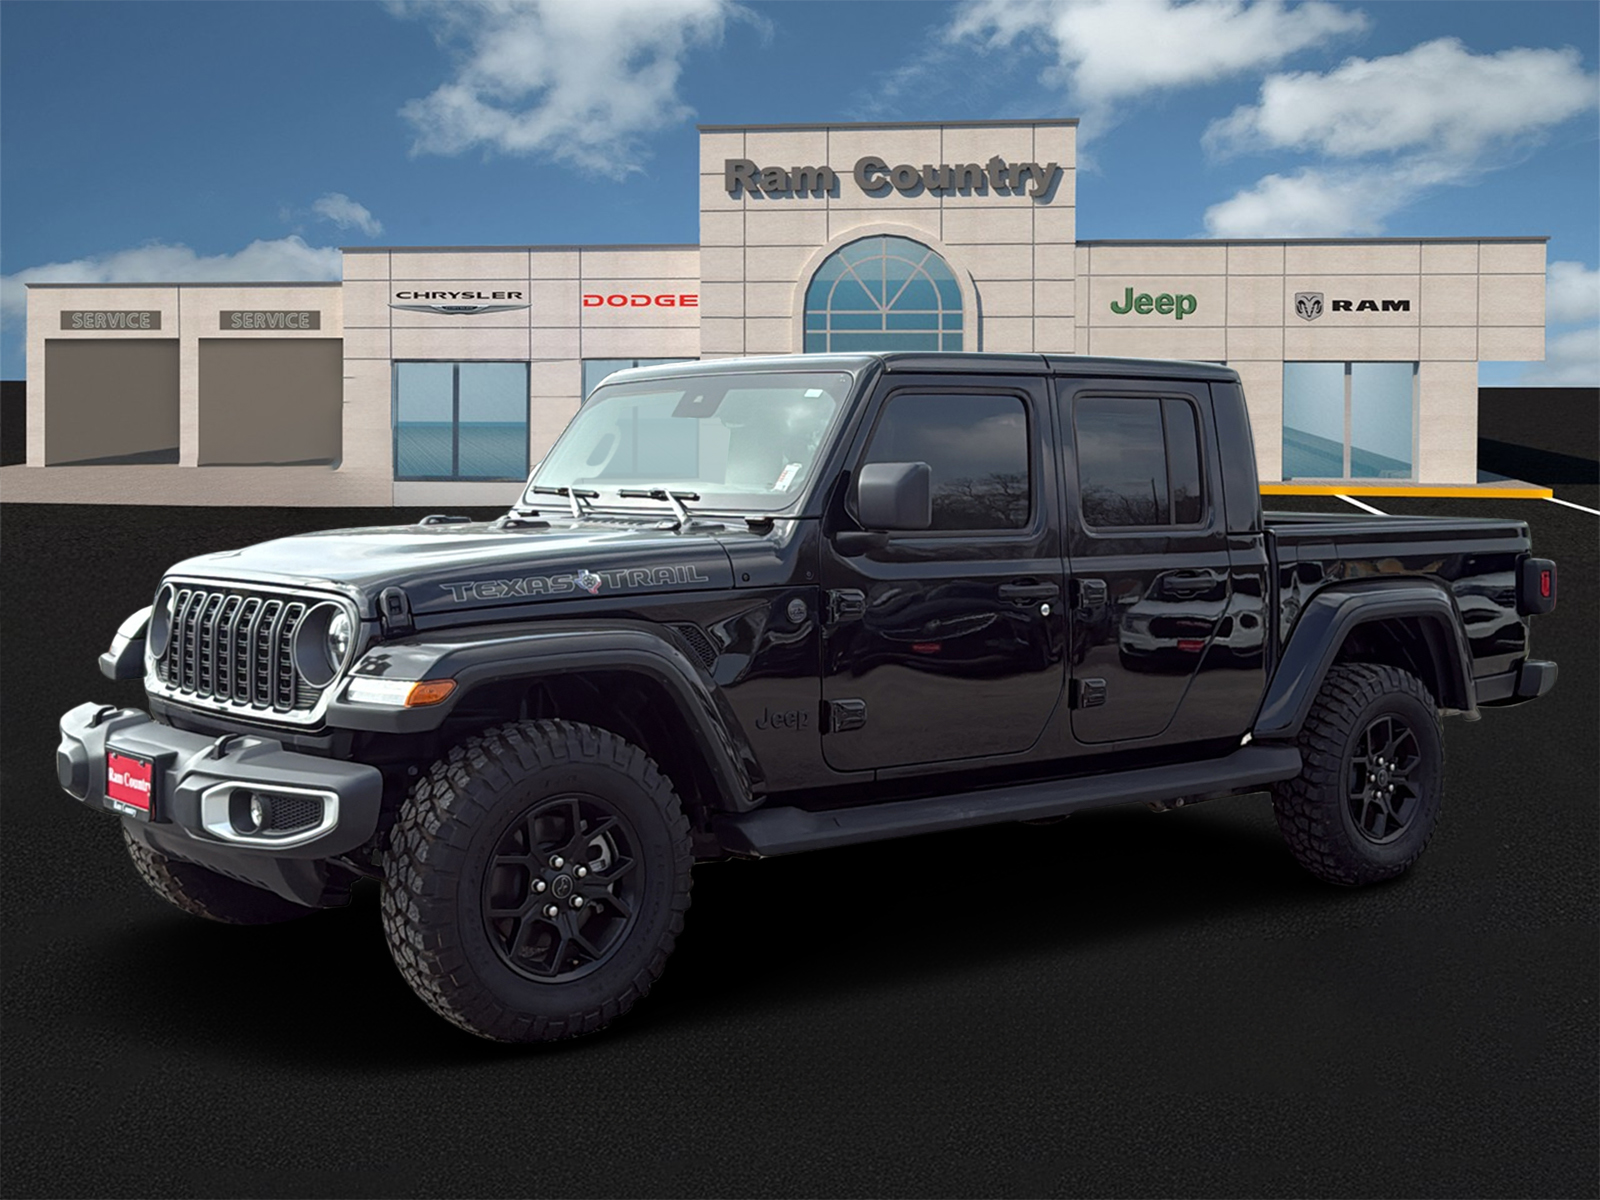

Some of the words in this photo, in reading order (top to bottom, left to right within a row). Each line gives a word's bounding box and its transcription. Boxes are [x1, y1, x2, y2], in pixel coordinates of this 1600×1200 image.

[724, 158, 837, 195] Ram
[853, 154, 1060, 201] Country
[395, 291, 523, 300] CHRYSLER
[583, 294, 699, 307] DODGE
[1110, 287, 1197, 320] Jeep
[1331, 299, 1411, 312] RAM
[72, 312, 151, 329] SERVICE
[231, 312, 310, 329] SERVICE
[440, 575, 575, 602] TEXAS
[600, 565, 709, 589] TRAIL
[755, 707, 809, 731] Jeep
[108, 767, 124, 785] Ram
